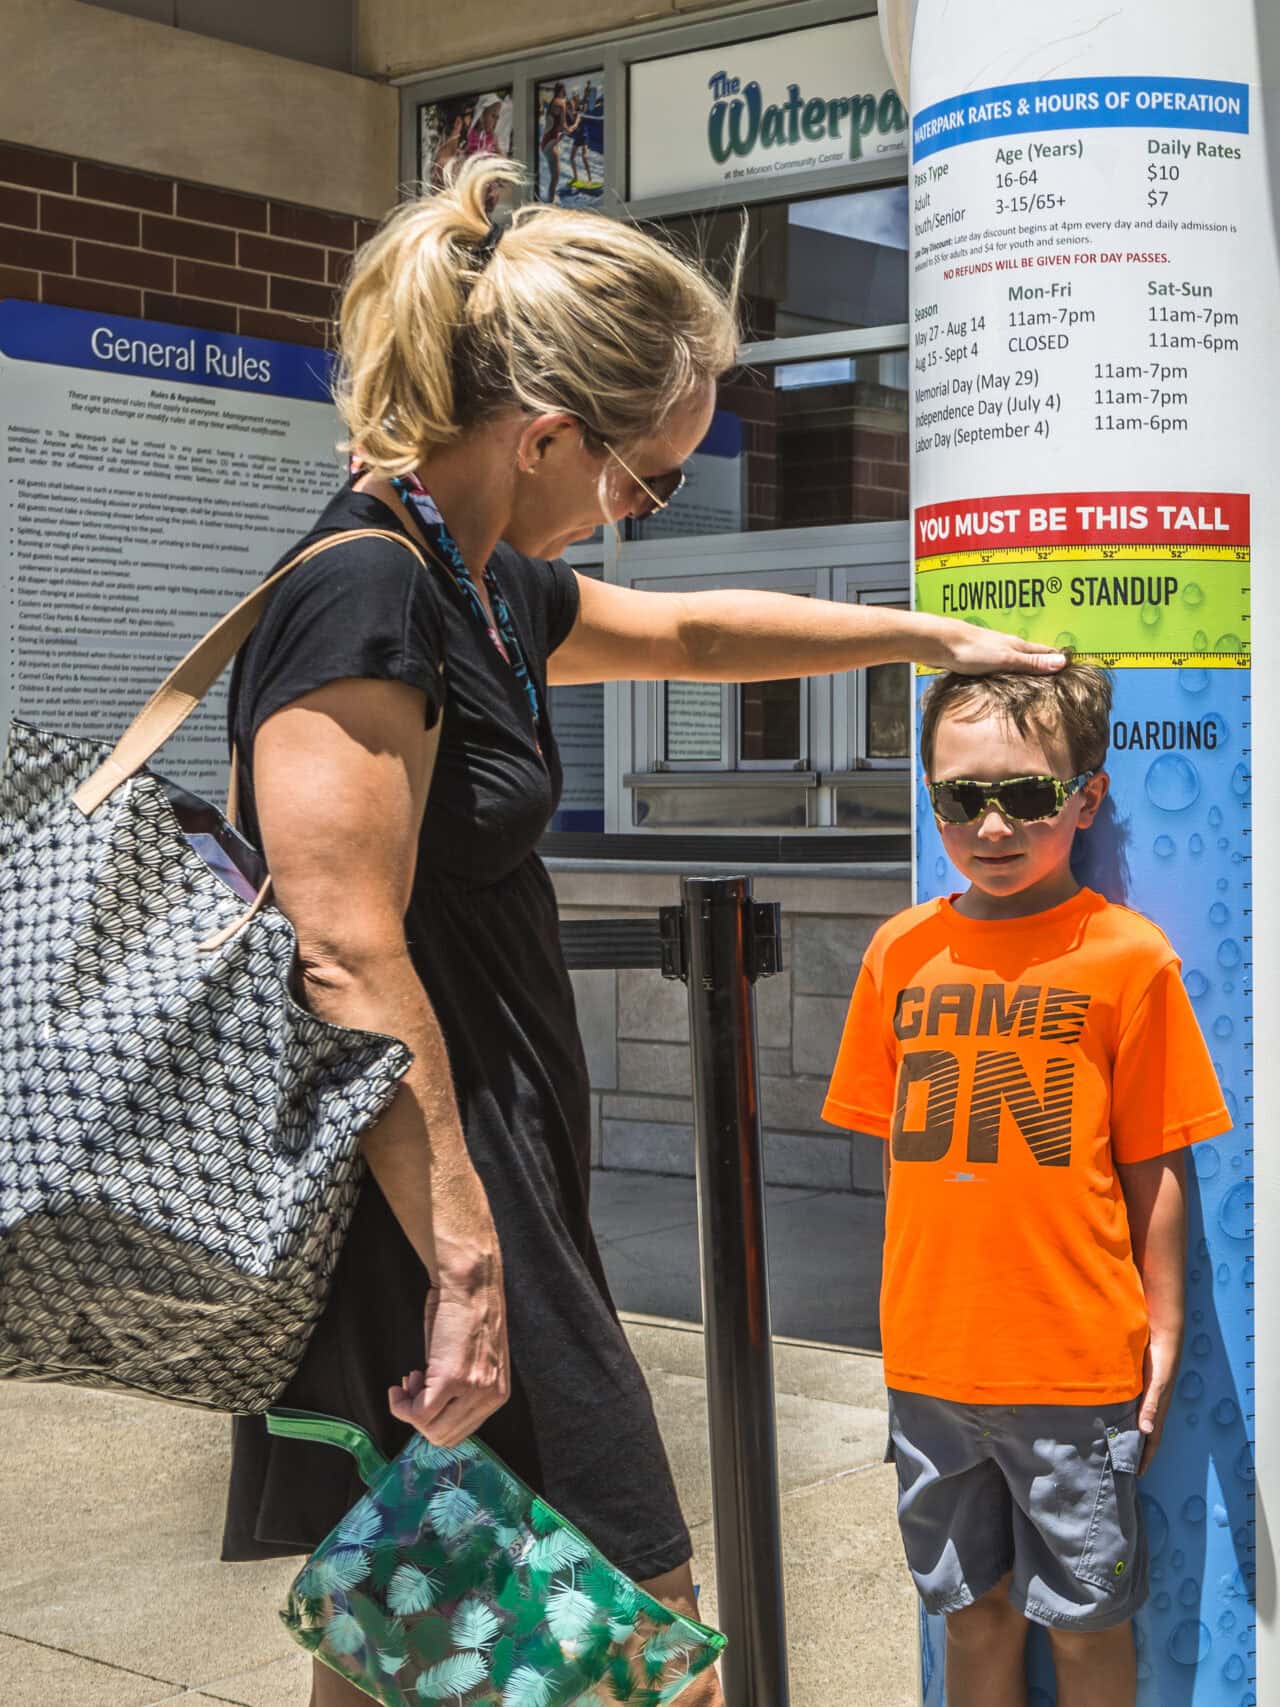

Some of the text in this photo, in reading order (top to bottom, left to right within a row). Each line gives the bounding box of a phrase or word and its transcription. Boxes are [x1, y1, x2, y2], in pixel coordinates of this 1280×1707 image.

[708, 70, 740, 100] The
[706, 81, 909, 164] Waterpa
[915, 91, 1241, 145] WATERPARK RATES & HOURS OF OPERATION
[724, 152, 844, 180] at the Monon Community Center
[914, 139, 1241, 188] Pass Type Age (Years) Daily Rates
[914, 163, 1180, 212] Adult 16-64 $10
[914, 189, 1169, 237] Youth/Senior 3-15/65+ $7
[954, 234, 968, 245] Late
[968, 231, 982, 244] day
[983, 225, 1016, 239] discount
[1018, 223, 1047, 235] begins
[1049, 222, 1059, 231] at
[1060, 221, 1083, 234] 4pm
[1085, 220, 1112, 231] every
[1114, 219, 1132, 231] day
[1134, 219, 1153, 229] and
[1155, 219, 1179, 231] daily
[1181, 220, 1228, 233] admission
[1230, 224, 1237, 233] is
[941, 251, 950, 262] for
[949, 247, 968, 260] adults
[969, 244, 983, 256] and
[984, 241, 994, 254] $4
[996, 240, 1007, 251] for
[1009, 237, 1034, 251] youth
[1036, 236, 1054, 246] and
[1056, 234, 1093, 246] seniors.
[943, 252, 1171, 281] NO REFUNDS WILL BE GIVEN FOR DAY PASSES.
[1008, 280, 1213, 301] Mon-Fri Sat-Sun
[914, 303, 938, 323] Season
[914, 331, 928, 347] May
[929, 325, 939, 342] 27
[946, 320, 967, 338] Aug
[970, 315, 986, 332] 14
[1008, 308, 1096, 327] 11am-7pm
[1148, 306, 1239, 327] 11am-7pm
[90, 327, 272, 383] General Rules
[914, 357, 927, 373] Aug
[928, 351, 937, 367] 15
[944, 345, 968, 363] Sept
[970, 342, 979, 357] 4
[1008, 334, 1069, 353] CLOSED
[1148, 332, 1239, 353] 11am-6pm
[150, 389, 169, 400] Rules
[170, 391, 177, 401] &
[914, 363, 1188, 403] Memorial Day (May 29) 11am-7pm
[68, 390, 89, 401] These
[90, 394, 101, 402] are
[102, 395, 129, 406] general
[129, 398, 146, 408] rules
[147, 400, 162, 410] that
[163, 403, 181, 413] apply
[182, 404, 189, 413] to
[222, 410, 264, 424] Management
[71, 403, 83, 412] the
[84, 404, 101, 415] right
[102, 406, 110, 415] to
[111, 407, 136, 419] change
[137, 411, 144, 419] or
[145, 411, 169, 424] modify
[170, 415, 186, 425] rules
[915, 389, 1188, 429] Independence Day (July 4) 11am-7pm
[914, 415, 1188, 453] Labor Day (September 4) 11am-6pm
[920, 505, 1230, 543] YOU MUST BE THIS TALL
[943, 576, 1178, 613] FLOWRIDER® STANDUP
[1112, 720, 1218, 751] OARDING
[892, 982, 1092, 1045] GAME
[891, 1049, 1076, 1167] ON
